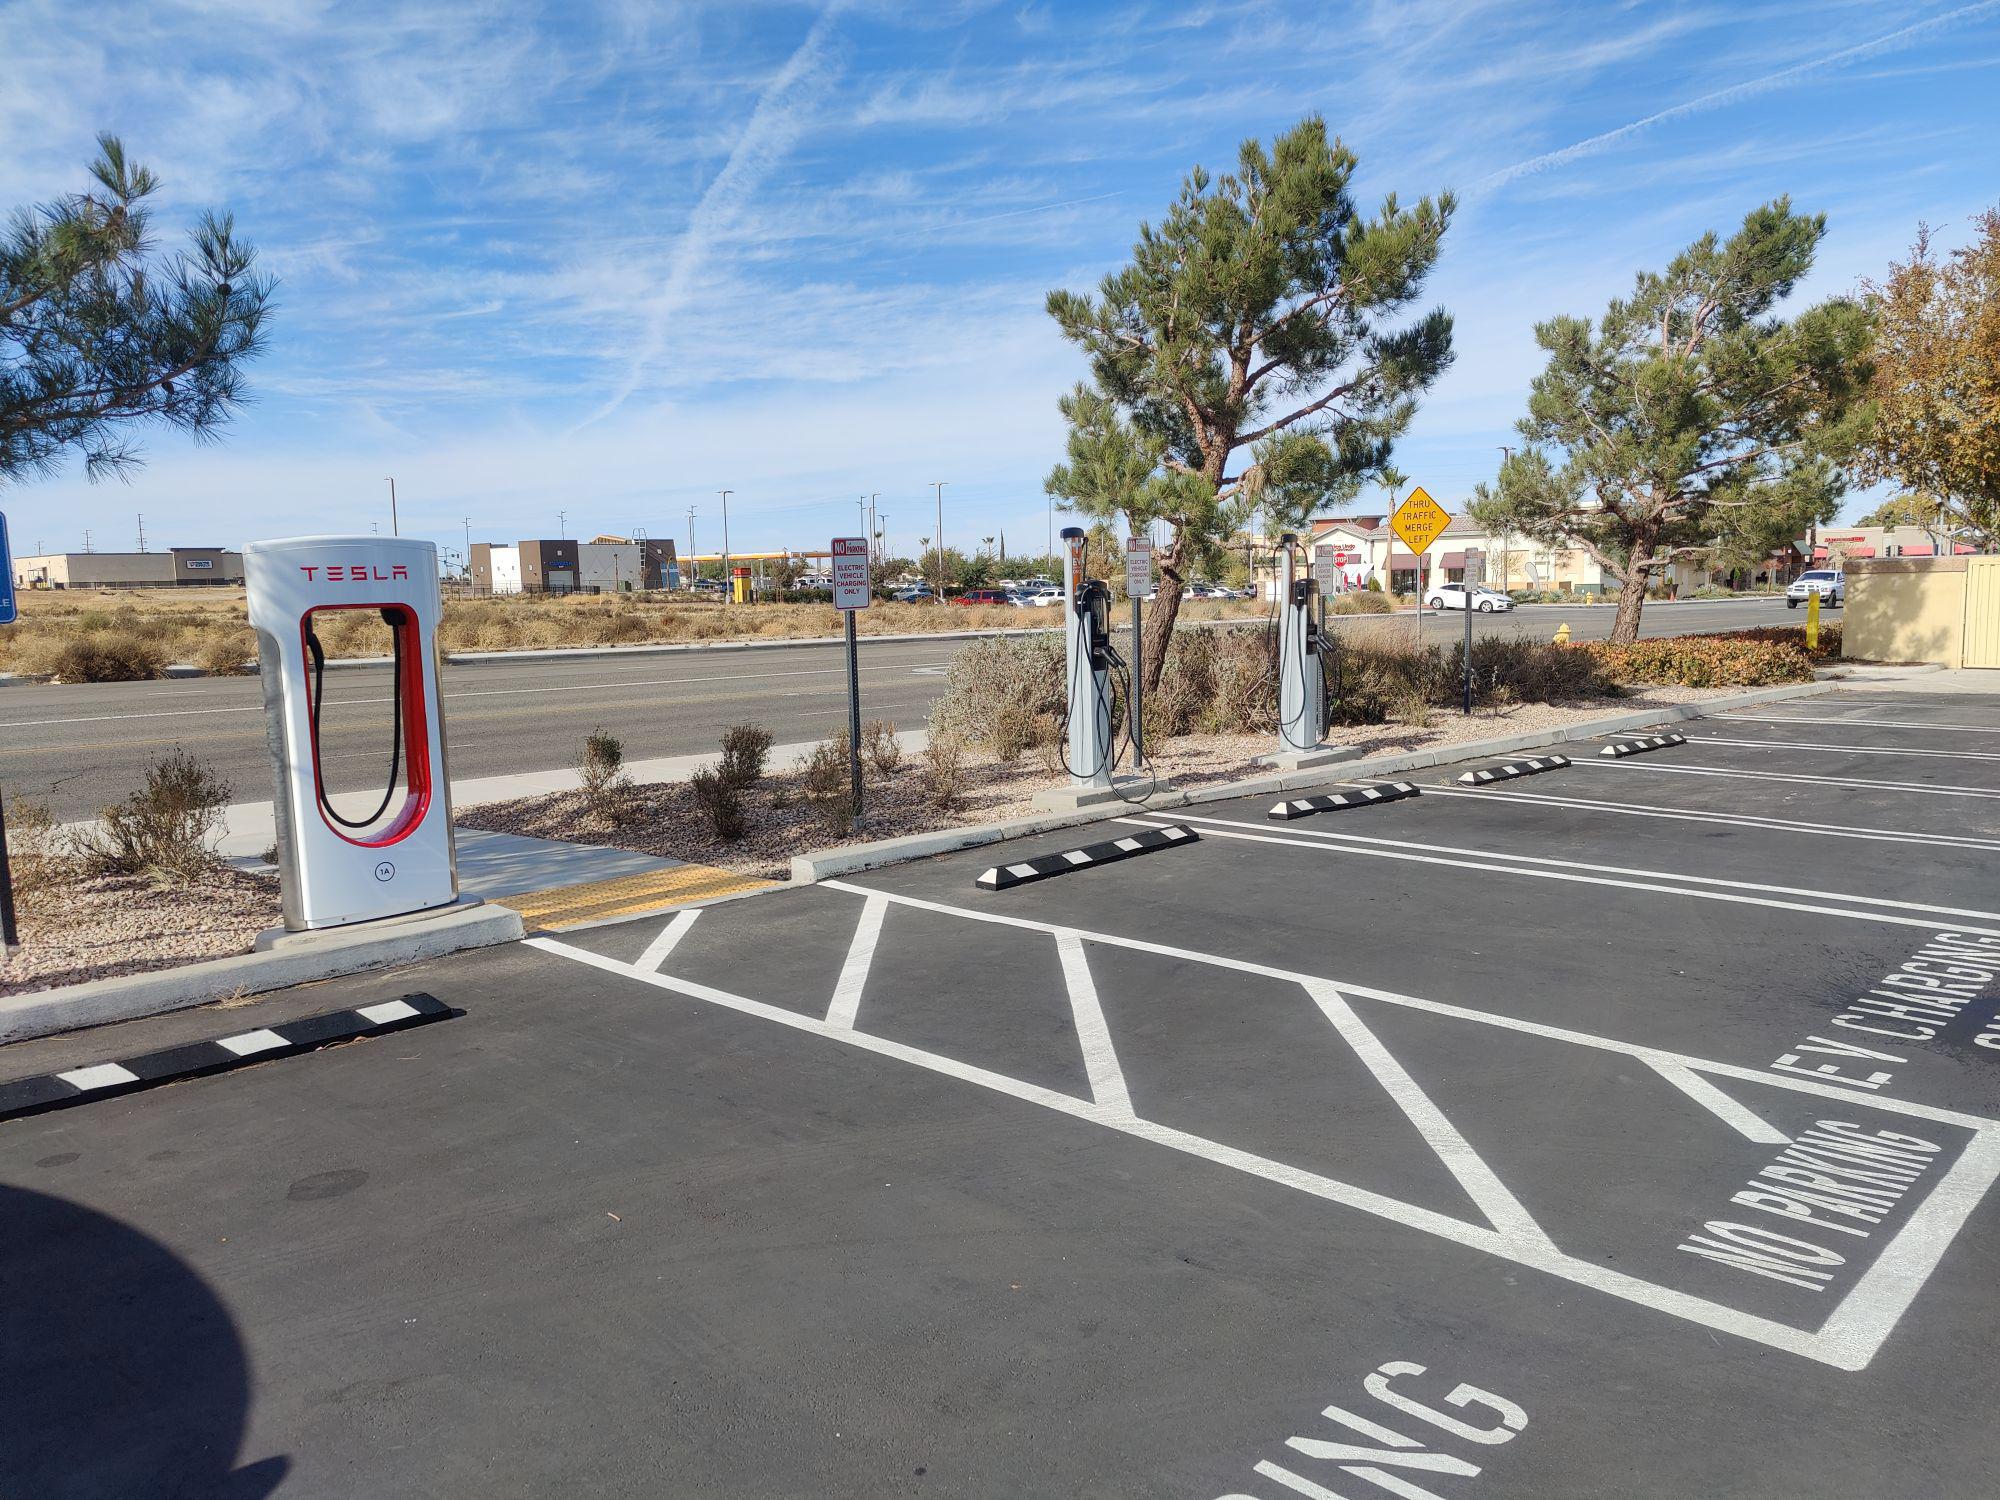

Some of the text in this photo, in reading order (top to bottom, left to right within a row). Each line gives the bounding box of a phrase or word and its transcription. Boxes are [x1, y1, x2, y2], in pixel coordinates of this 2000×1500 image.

[1409, 500, 1430, 508] THRU
[1402, 511, 1437, 520] TRAFFIC
[1405, 523, 1433, 532] MERGE
[1408, 535, 1429, 544] LEFT
[834, 542, 865, 554] NO PARKING
[300, 565, 408, 581] TESLA
[380, 868, 391, 876] 1A
[1831, 933, 2000, 1041] CHARGING
[1770, 1035, 1908, 1090] EV
[1677, 1120, 1942, 1292] NO PARKING
[1214, 1361, 1529, 1500] ING
